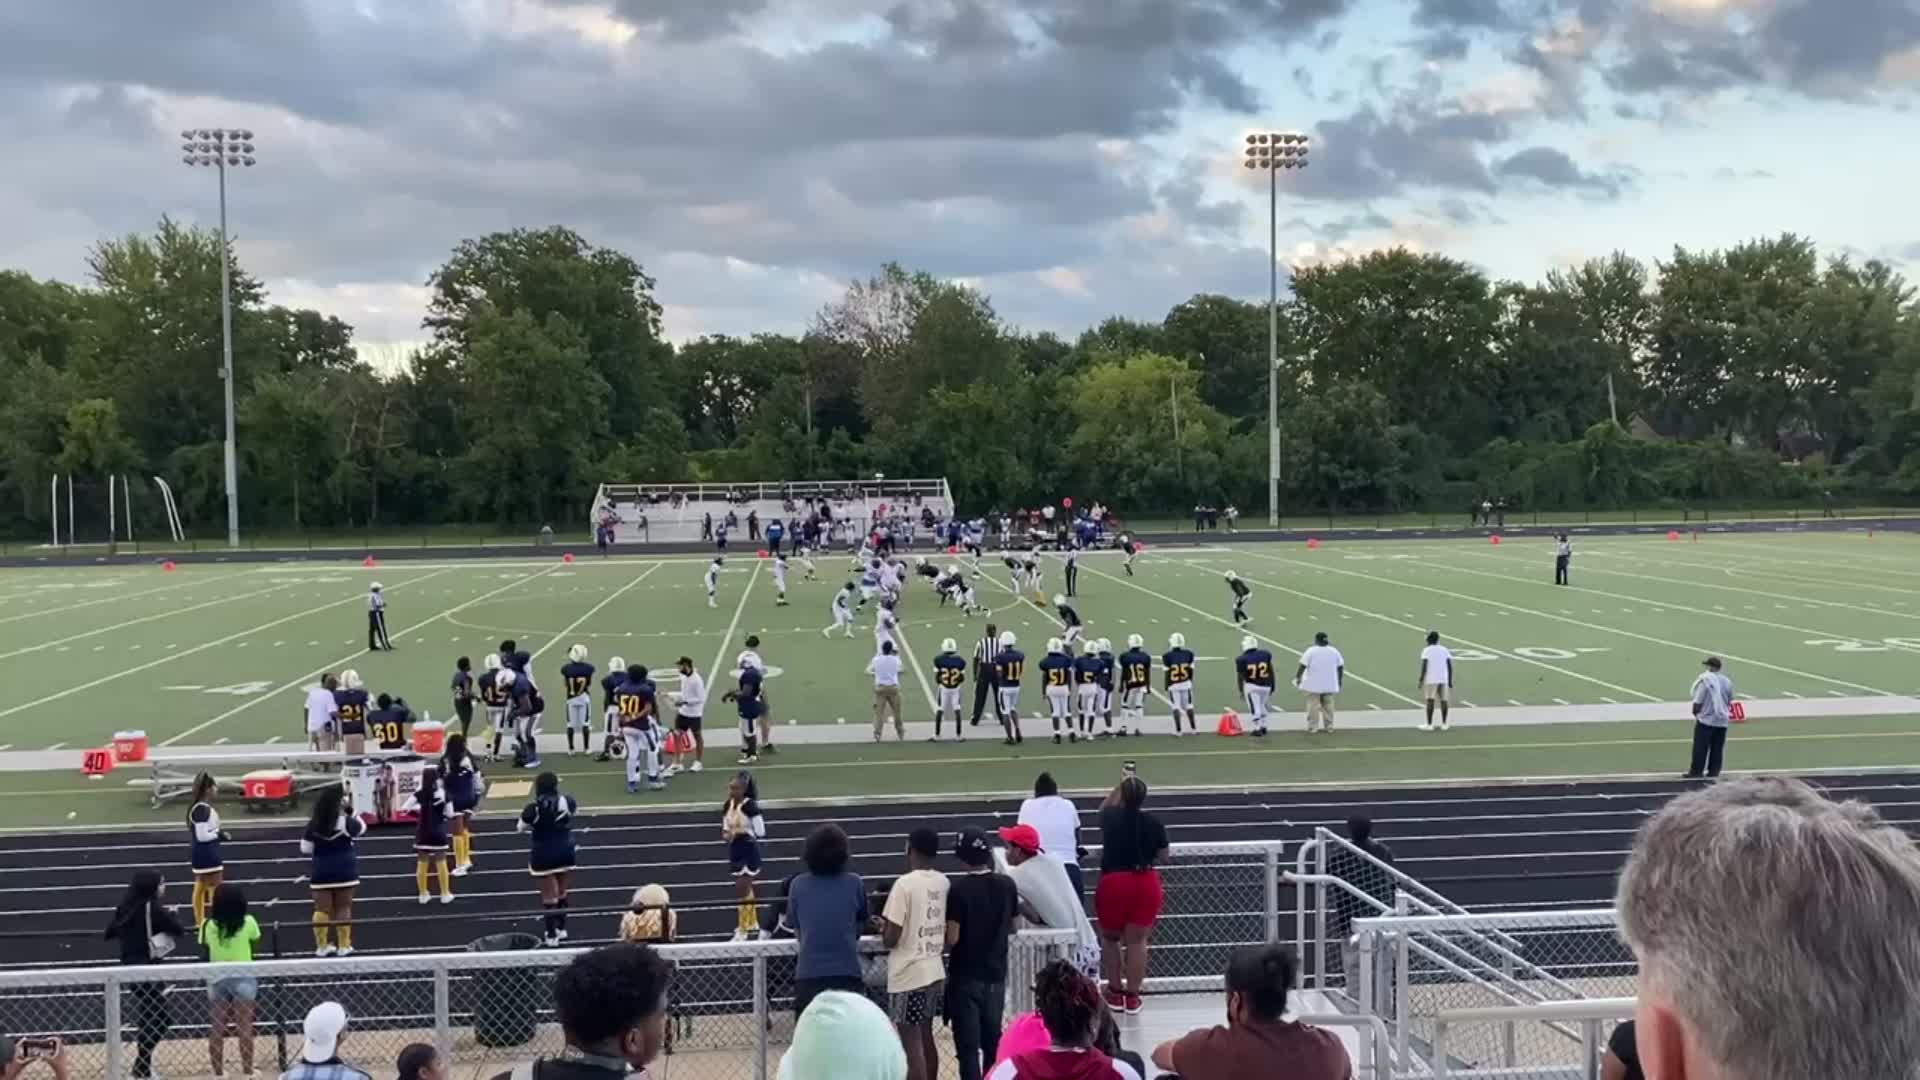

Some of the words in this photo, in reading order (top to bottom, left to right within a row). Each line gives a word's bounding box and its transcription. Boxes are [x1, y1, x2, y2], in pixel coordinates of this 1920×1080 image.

[941, 668, 961, 685] 22
[1007, 661, 1021, 680] 11
[1049, 668, 1065, 685] 51
[1129, 663, 1145, 683] 16
[1170, 664, 1189, 682] 25
[1247, 662, 1269, 679] 72
[568, 677, 587, 696] 17
[619, 694, 640, 716] 50
[83, 752, 106, 771] 40
[252, 783, 266, 797] G
